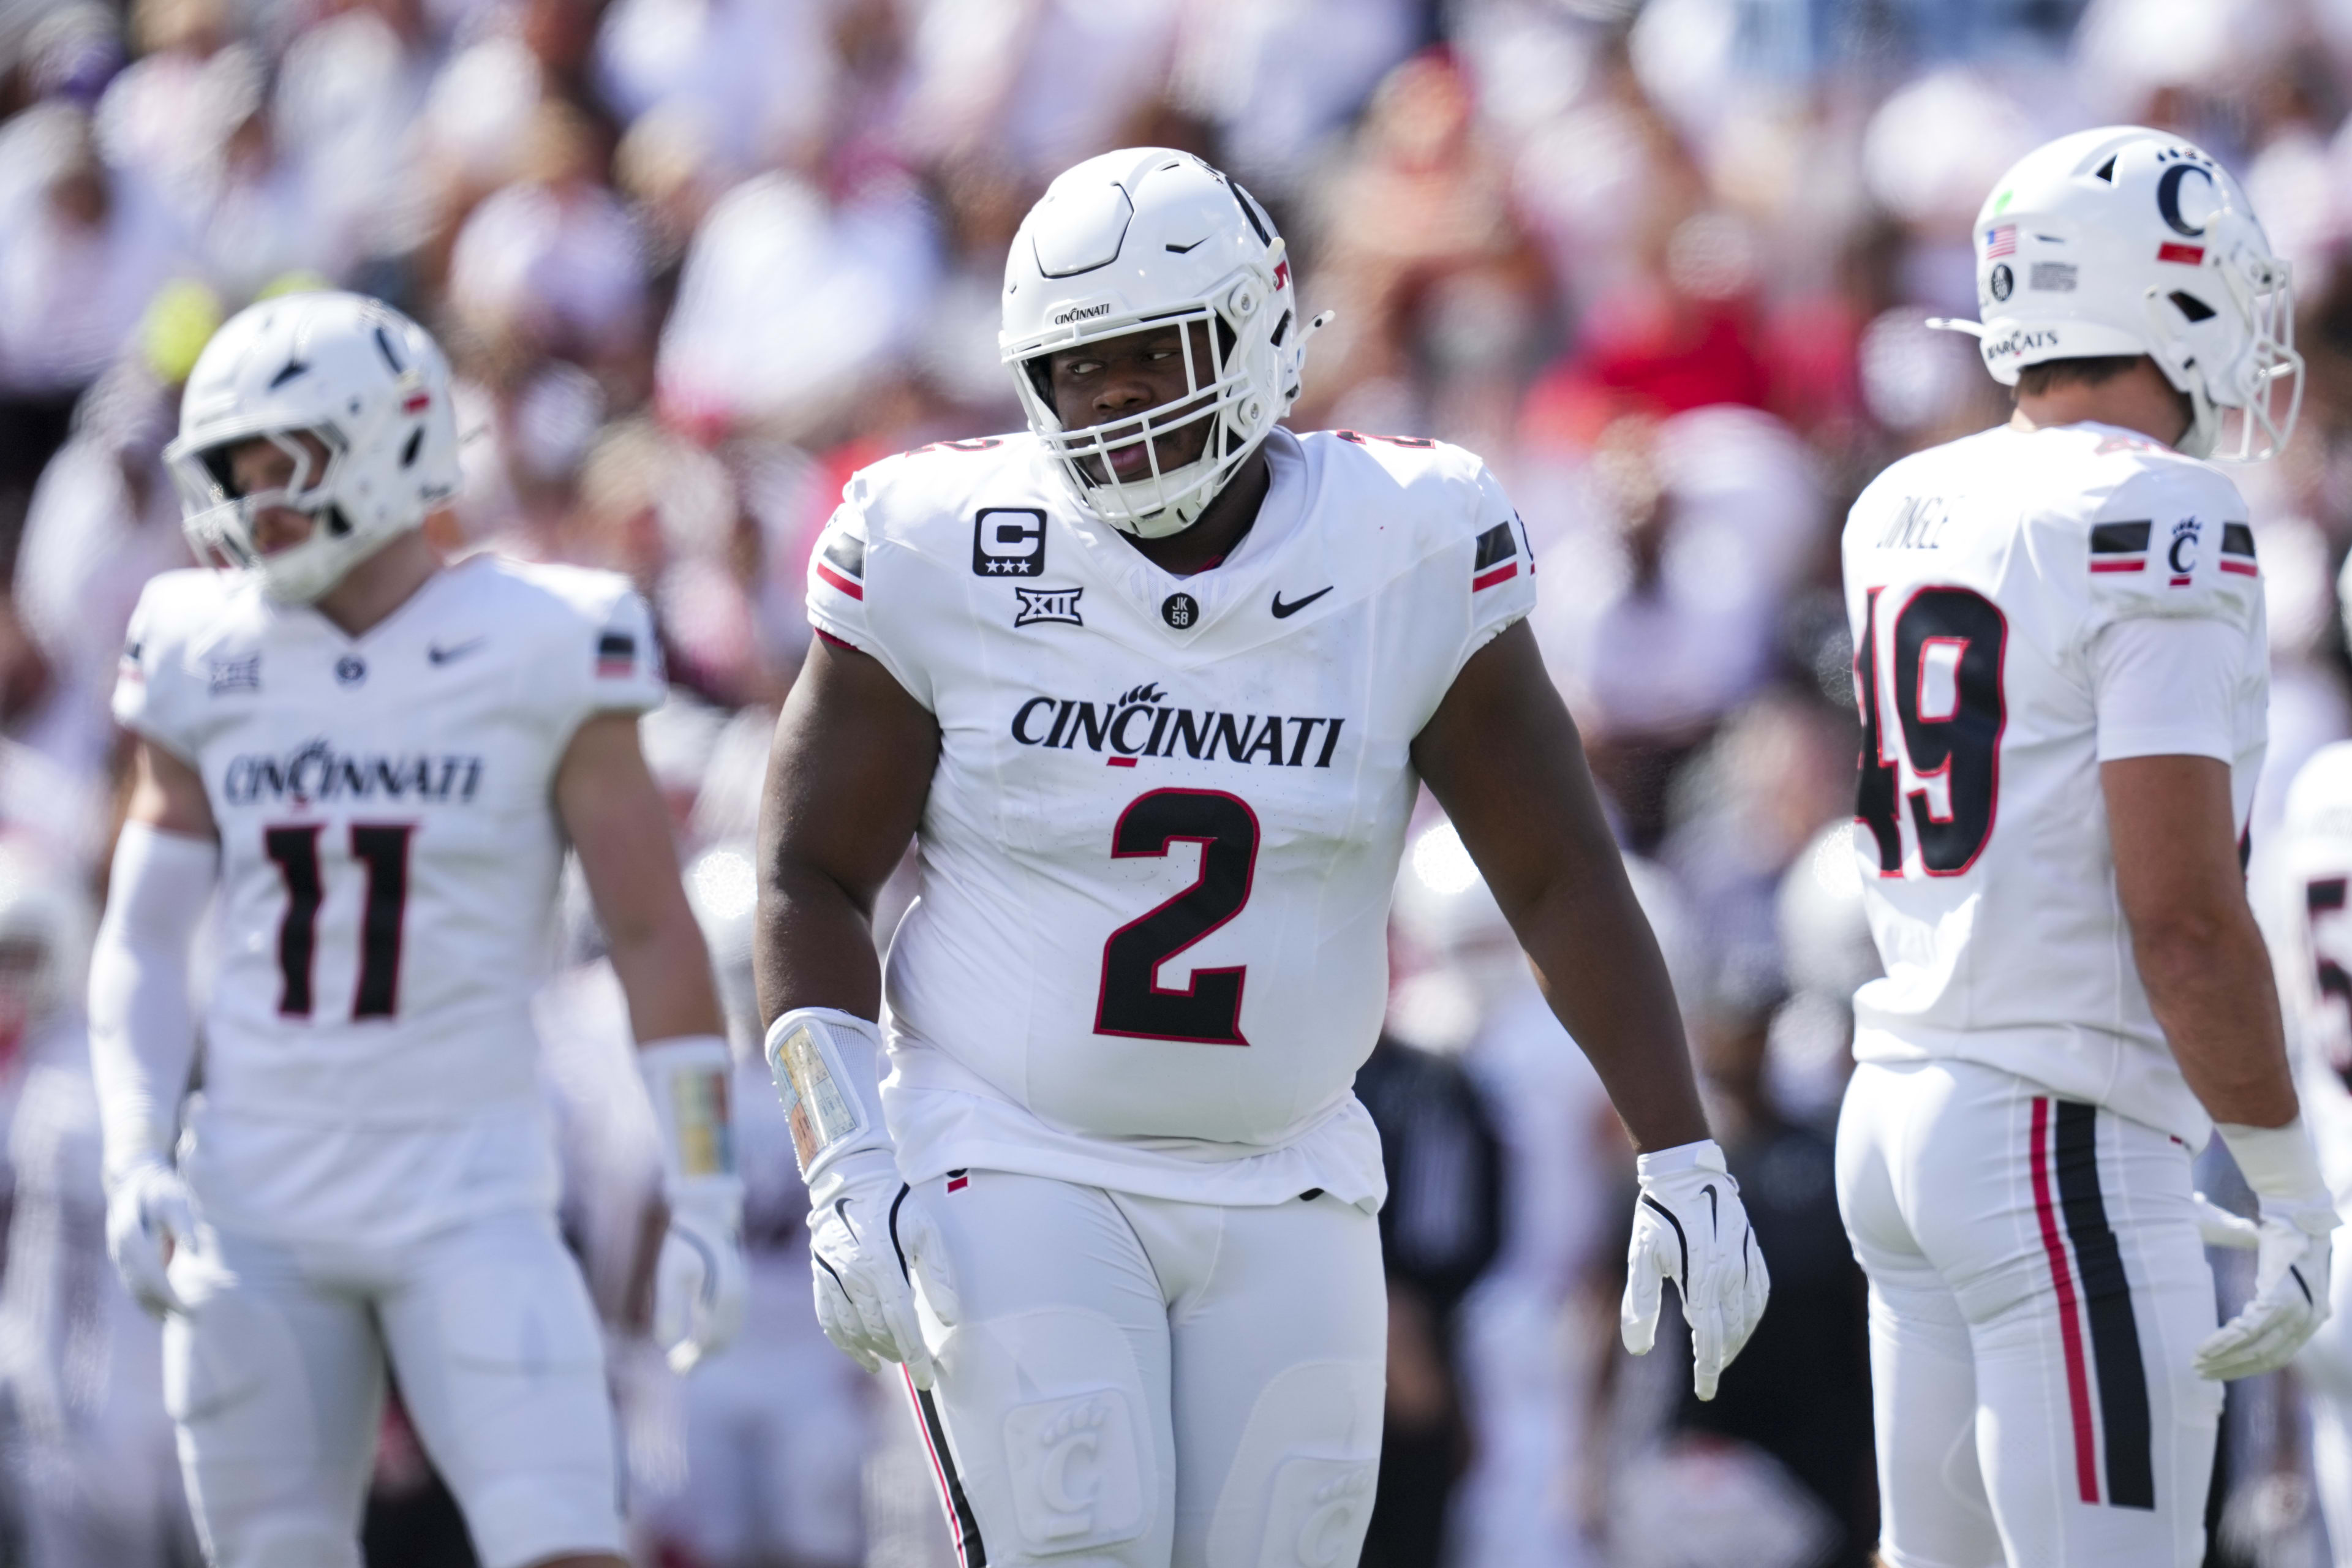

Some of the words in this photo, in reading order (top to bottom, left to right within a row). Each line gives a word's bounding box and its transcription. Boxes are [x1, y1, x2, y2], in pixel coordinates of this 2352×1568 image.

[1055, 303, 1109, 325] CINCINNATI
[980, 511, 1039, 557] C
[1017, 589, 1081, 624] XII
[1172, 597, 1188, 611] JK
[1172, 611, 1189, 625] 58
[1011, 682, 1345, 768] CINCINNATI
[224, 739, 484, 807] CINCINNATI
[264, 820, 421, 1023] 11
[1093, 786, 1261, 1046] 2
